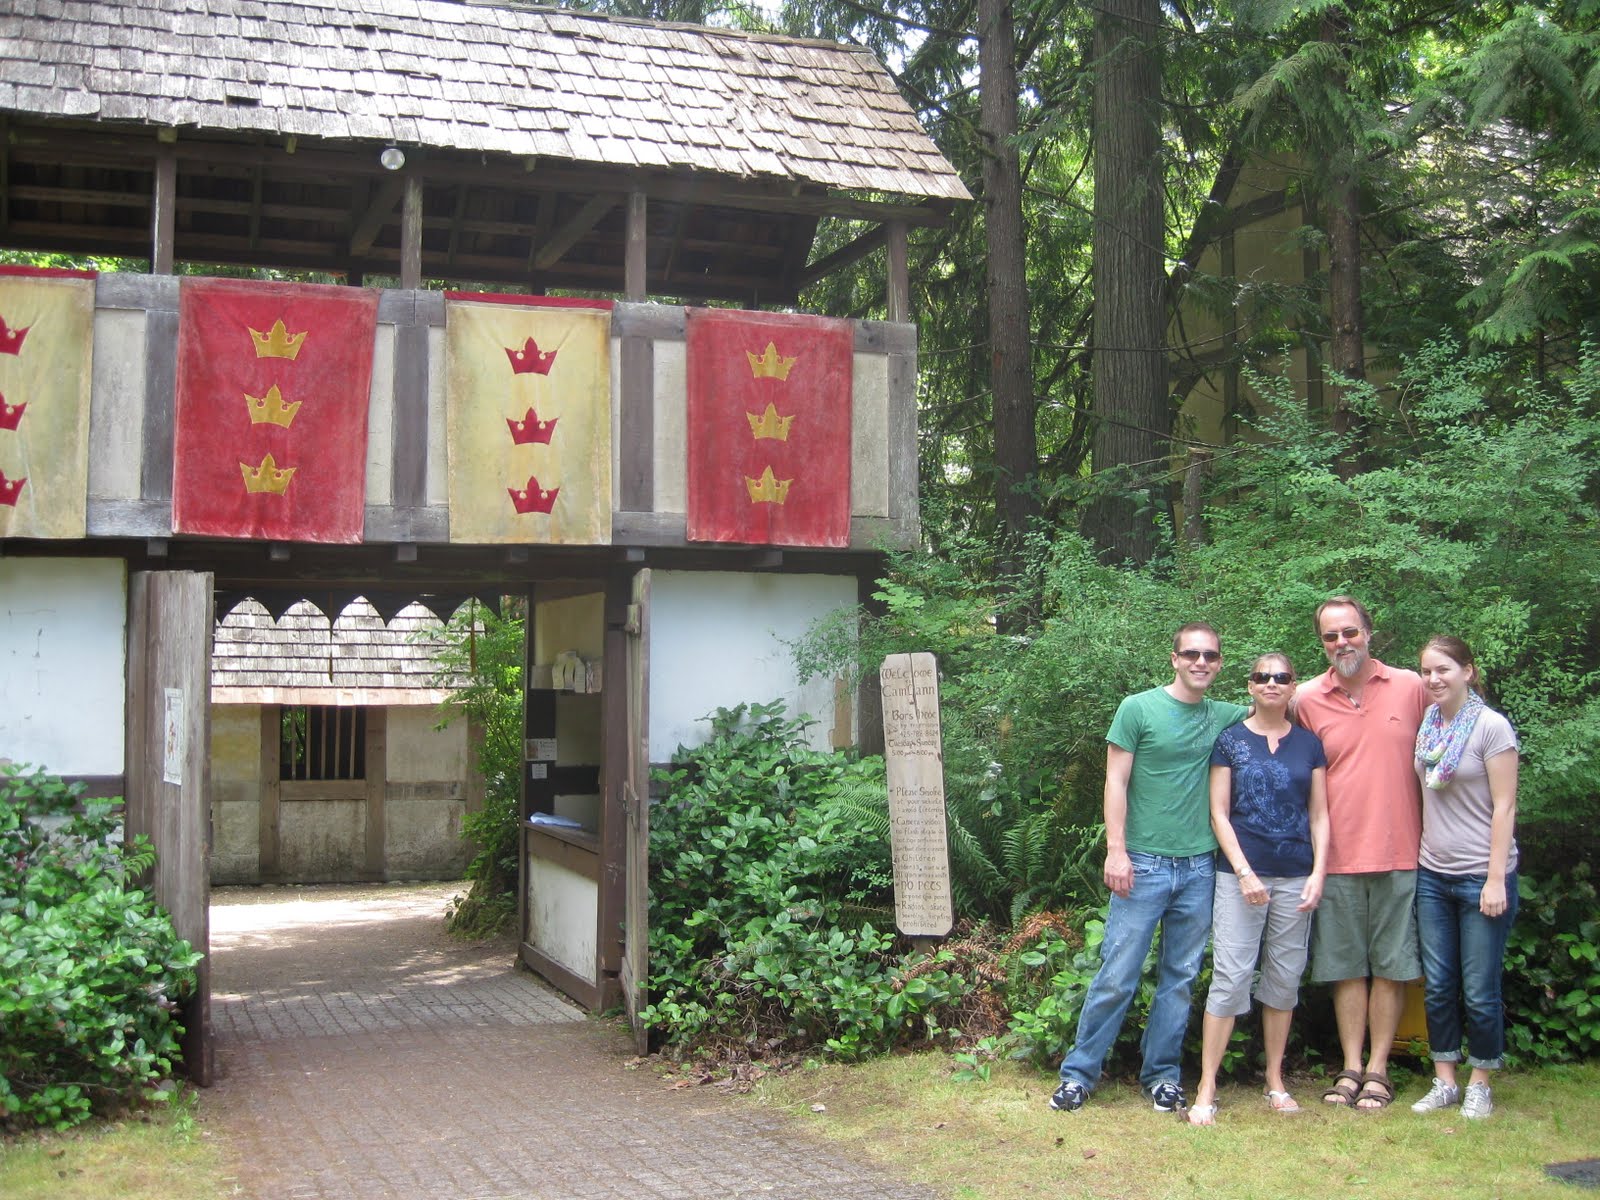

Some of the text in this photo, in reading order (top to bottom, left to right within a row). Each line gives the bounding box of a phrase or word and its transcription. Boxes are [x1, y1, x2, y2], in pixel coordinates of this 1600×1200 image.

[882, 683, 935, 697] Camlann
[892, 709, 914, 720] Bors
[901, 854, 936, 862] Children
